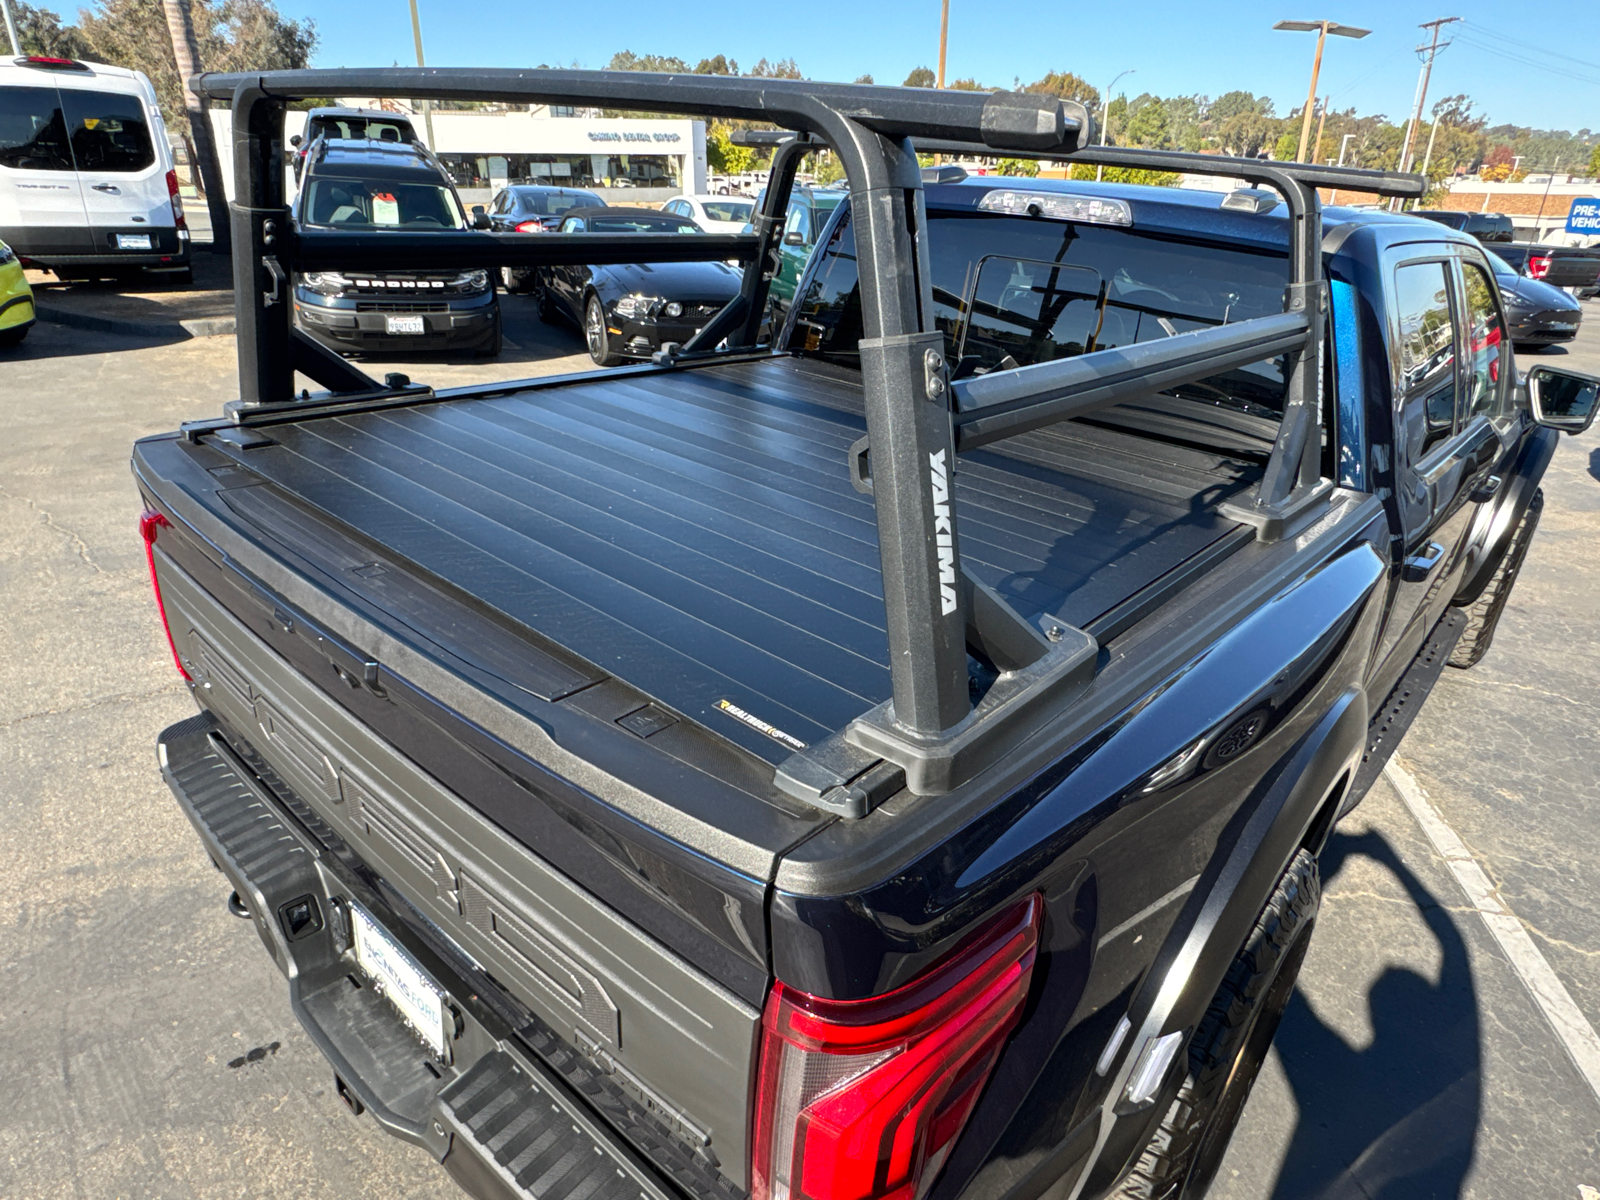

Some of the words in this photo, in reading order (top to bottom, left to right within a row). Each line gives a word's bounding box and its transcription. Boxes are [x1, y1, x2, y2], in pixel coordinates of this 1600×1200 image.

[588, 131, 622, 142] CAMINO
[622, 132, 652, 142] DENTAL
[653, 133, 681, 142] GROUP
[356, 280, 444, 288] BRONCO
[929, 448, 957, 616] YAKIMA
[188, 628, 623, 1052] FORD
[411, 994, 439, 1025] FORD
